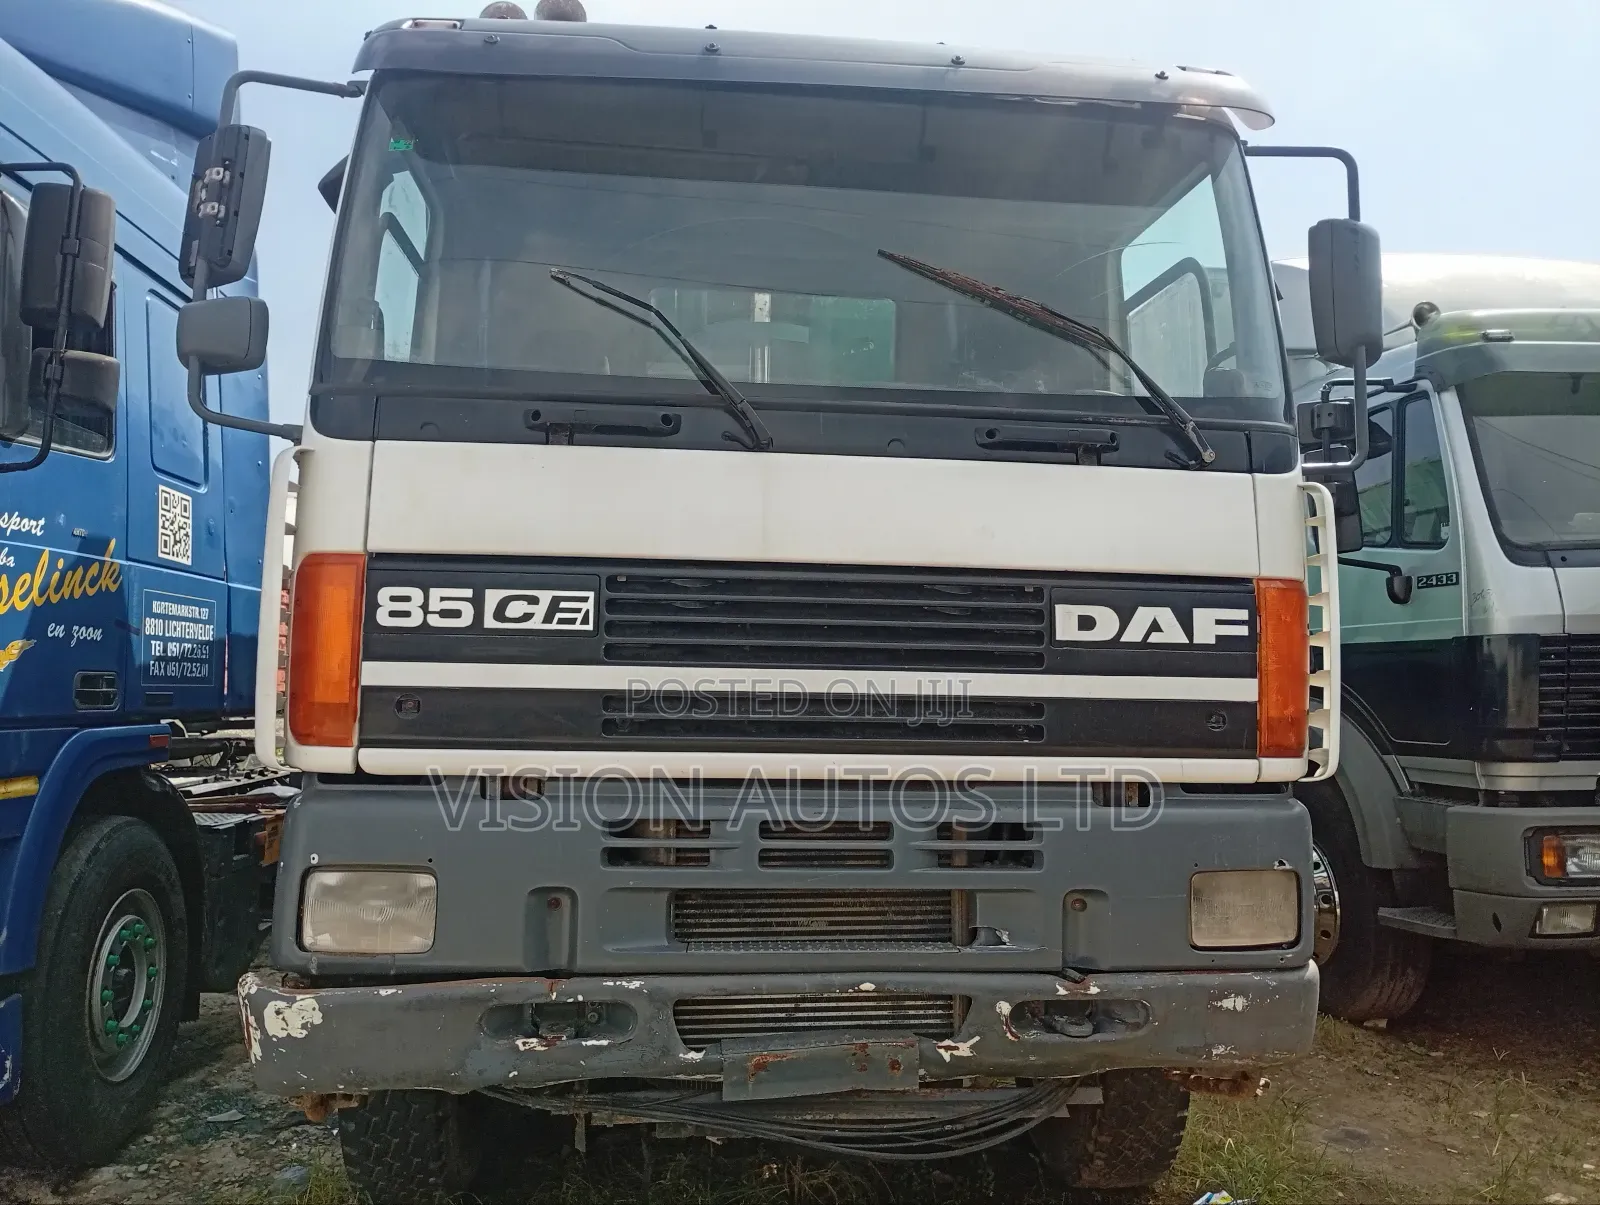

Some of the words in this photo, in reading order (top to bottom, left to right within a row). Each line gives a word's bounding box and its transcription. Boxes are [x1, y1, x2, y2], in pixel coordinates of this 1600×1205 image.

[1418, 573, 1457, 587] 2433
[376, 586, 475, 628] 85
[48, 622, 66, 638] en
[70, 624, 103, 648] zoon
[145, 617, 164, 636] 8810
[164, 619, 214, 641] LICHTERVELDE
[1054, 603, 1249, 645] DAF
[149, 660, 166, 677] FAX
